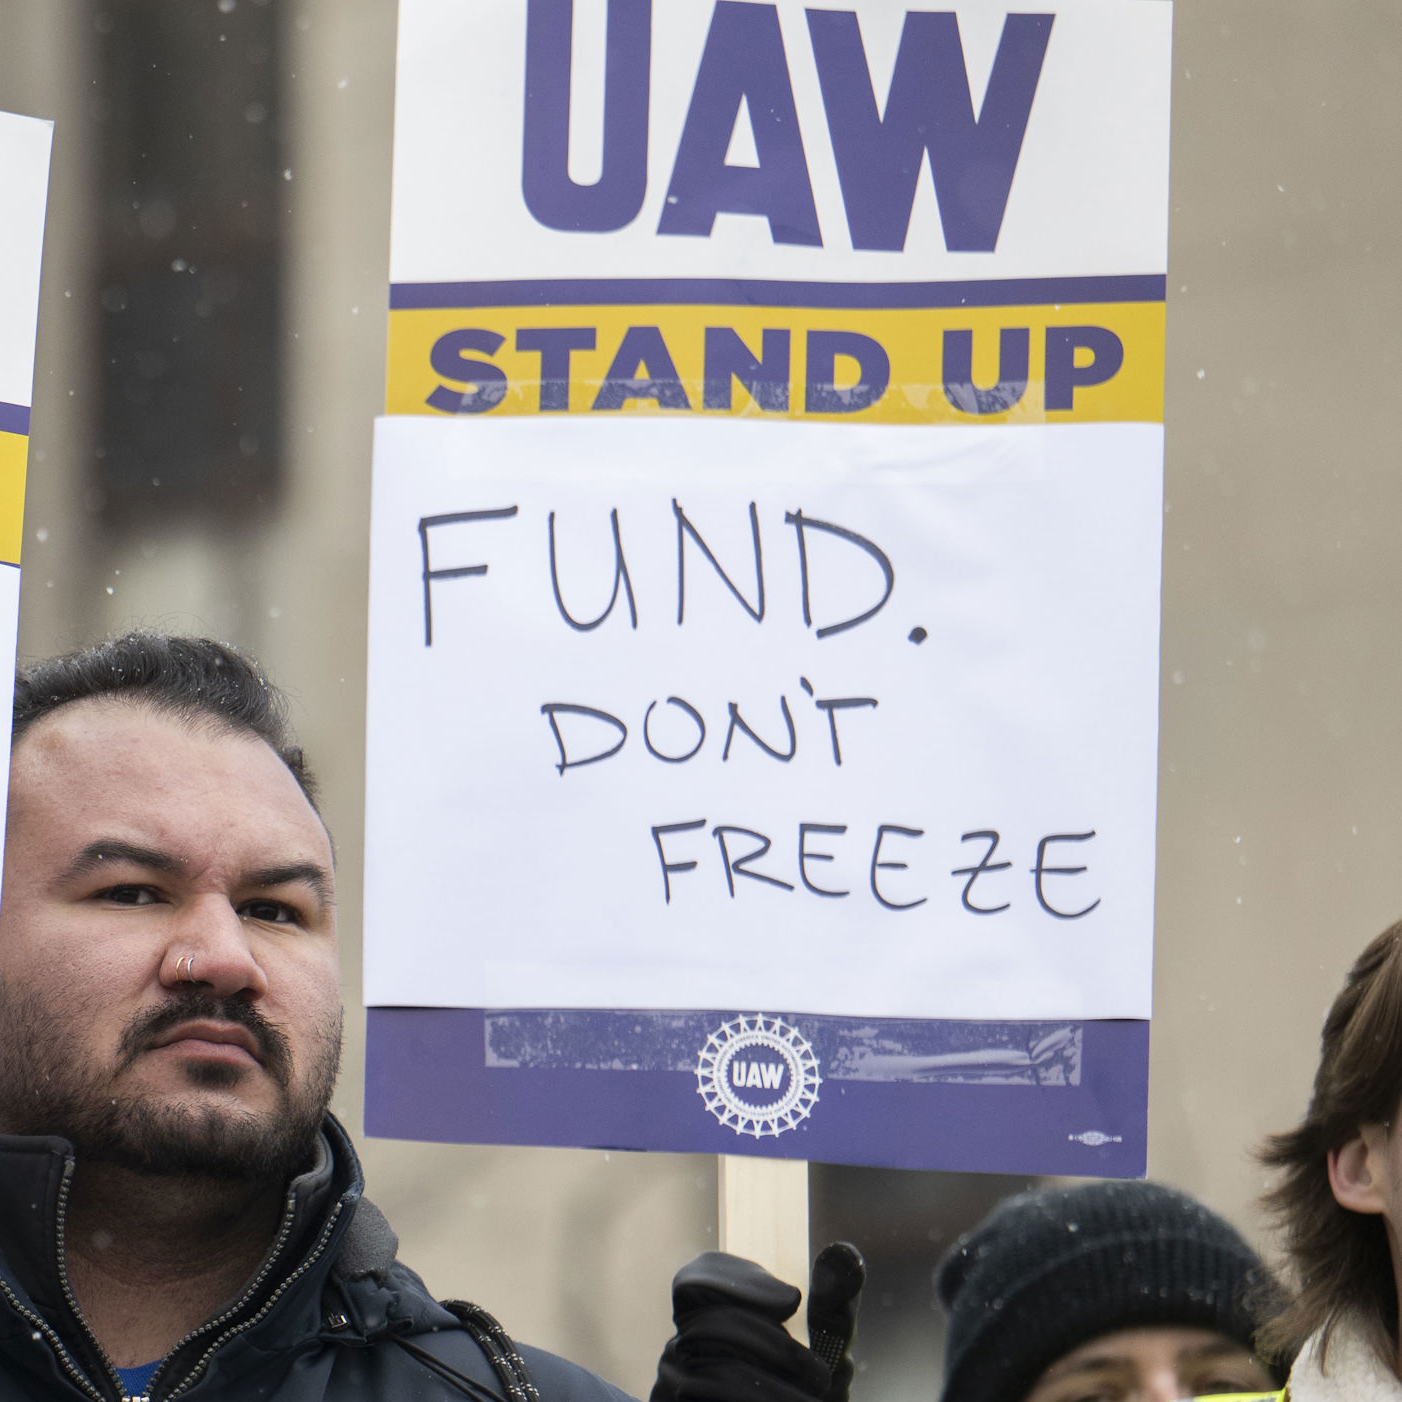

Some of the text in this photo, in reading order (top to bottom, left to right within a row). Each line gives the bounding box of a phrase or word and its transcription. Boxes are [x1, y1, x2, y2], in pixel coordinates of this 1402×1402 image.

[521, 0, 1057, 253] UAW
[424, 325, 1125, 415] STAND UP
[417, 497, 928, 648] FUND.
[540, 676, 879, 777] DON'T
[650, 818, 1101, 920] FREEZE
[730, 1058, 787, 1091] UAW
